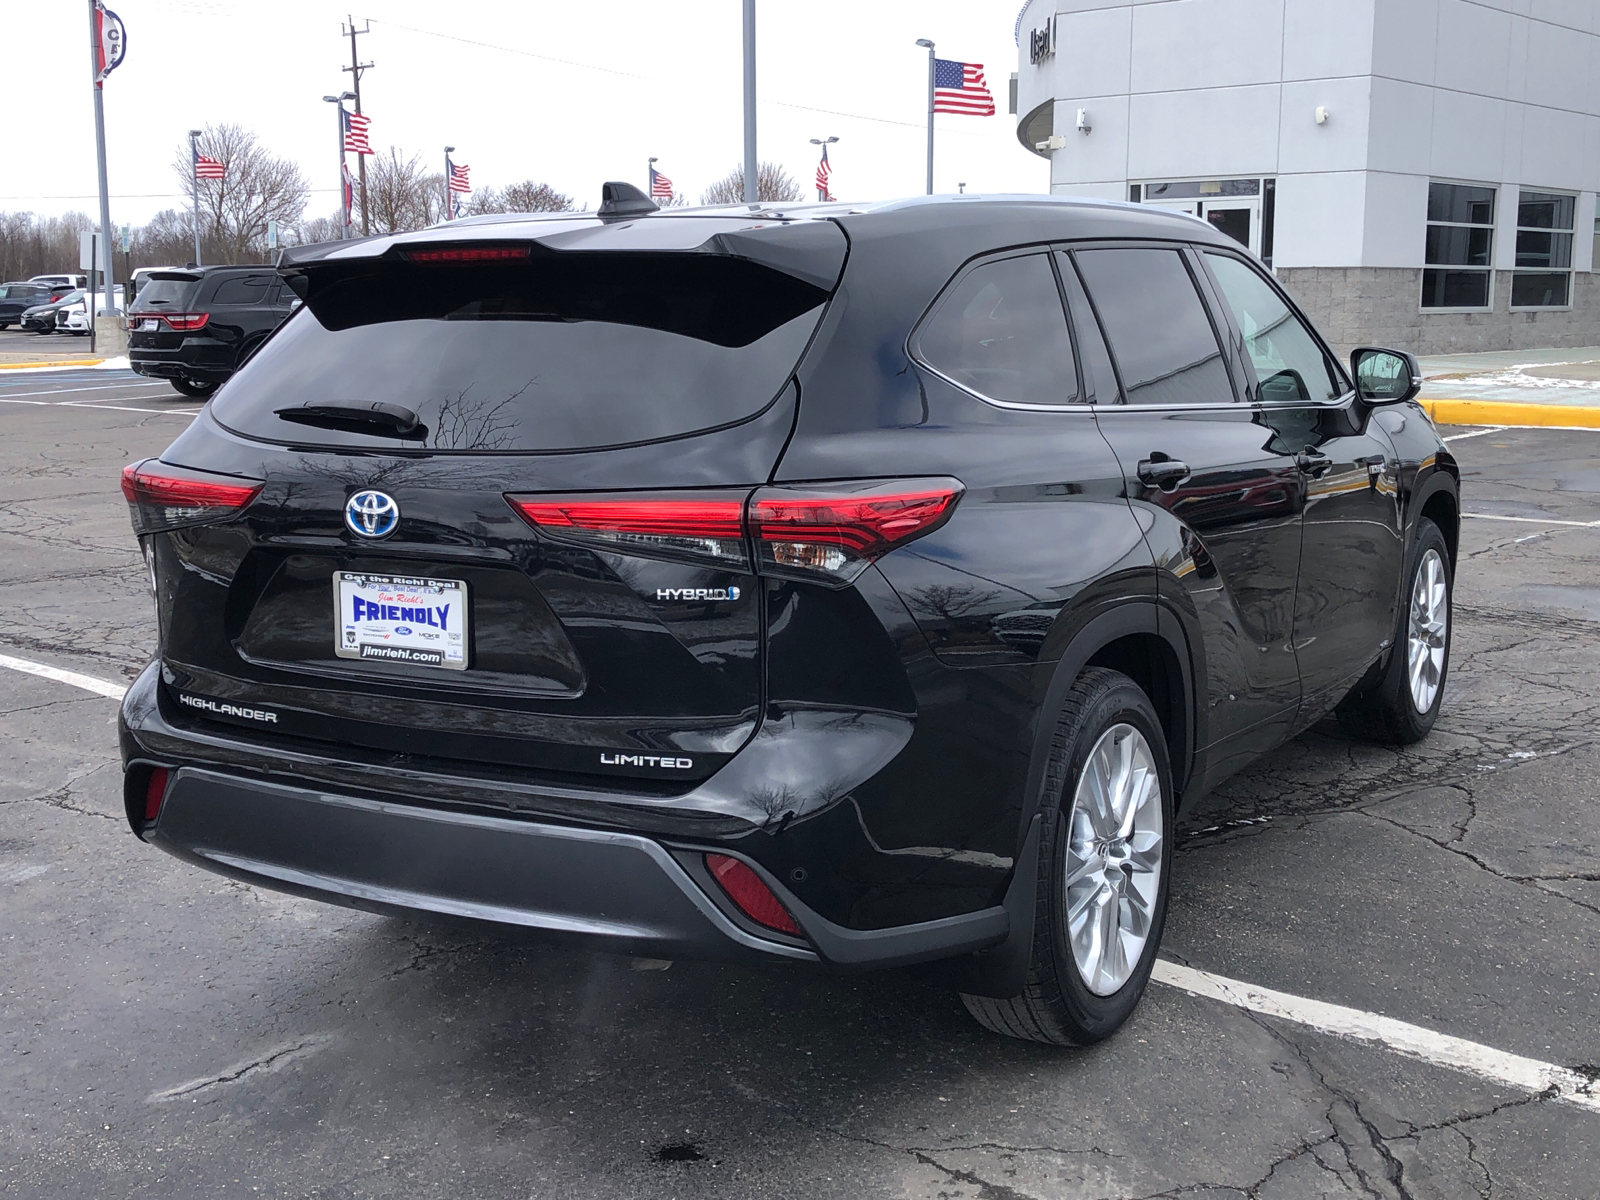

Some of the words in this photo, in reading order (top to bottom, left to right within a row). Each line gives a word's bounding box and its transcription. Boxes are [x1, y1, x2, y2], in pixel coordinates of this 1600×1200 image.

[1031, 17, 1050, 65] Used
[344, 574, 367, 582] Get
[369, 574, 390, 583] the
[393, 577, 424, 586] Riehl
[428, 580, 455, 588] Deal
[377, 592, 394, 603] Jim
[396, 593, 424, 604] Riehl's
[656, 588, 727, 600] HYBRID
[353, 594, 450, 631] FRIENDLY
[362, 645, 440, 662] jimriehl.com
[180, 694, 278, 723] HIGHLANDER
[600, 753, 693, 769] LIMITED
